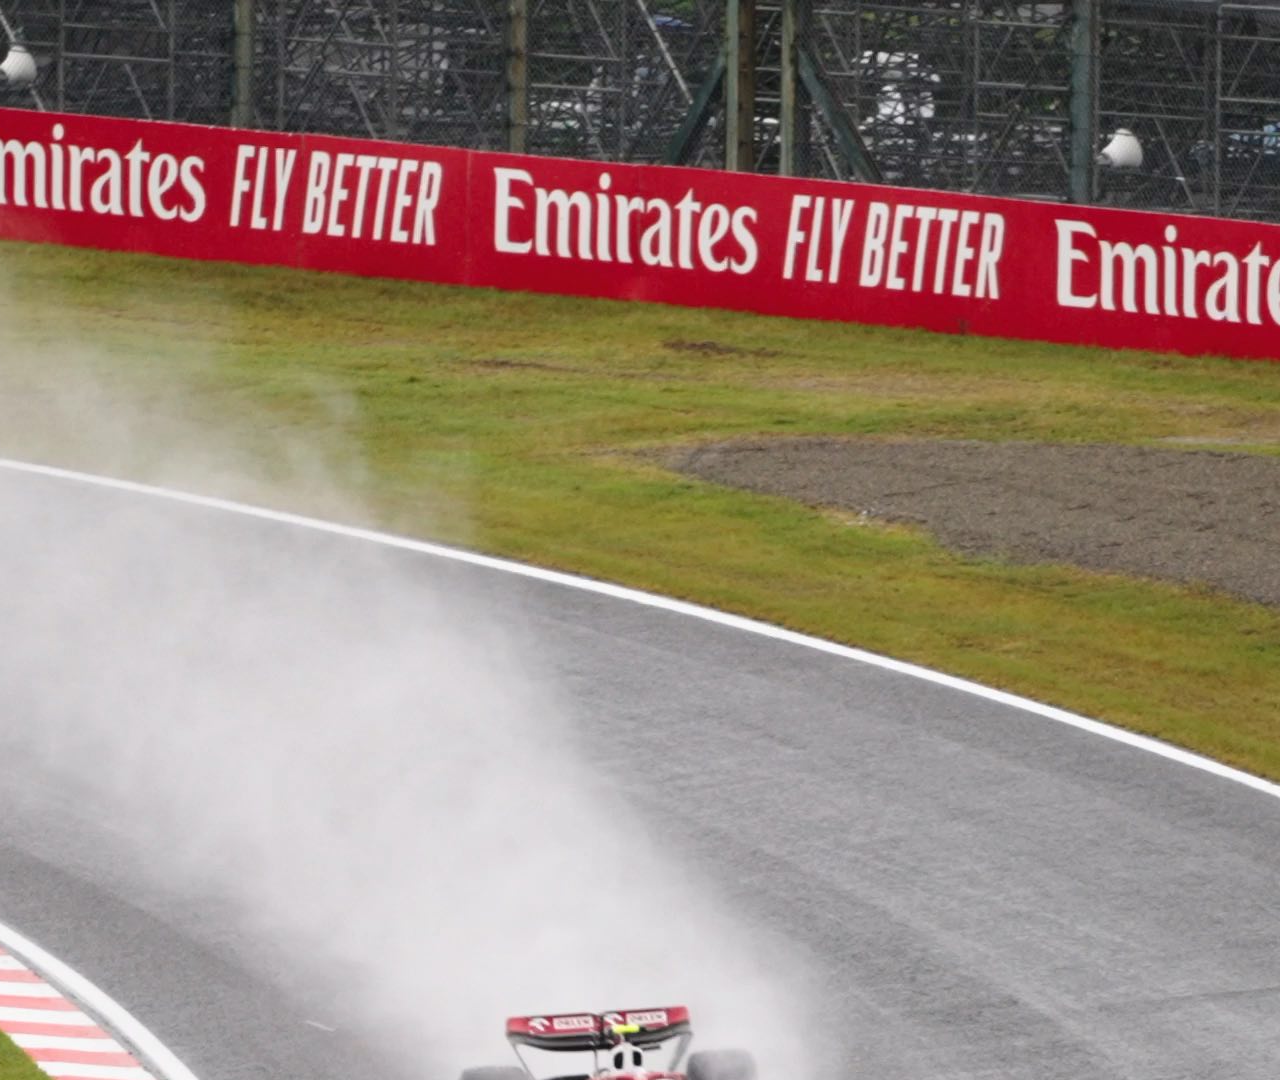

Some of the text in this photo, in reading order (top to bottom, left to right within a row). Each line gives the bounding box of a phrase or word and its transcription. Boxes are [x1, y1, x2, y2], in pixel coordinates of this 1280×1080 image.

[230, 144, 297, 231] FLY
[302, 150, 443, 246] BETTER
[493, 167, 1005, 300] Emirates FLY BETTER
